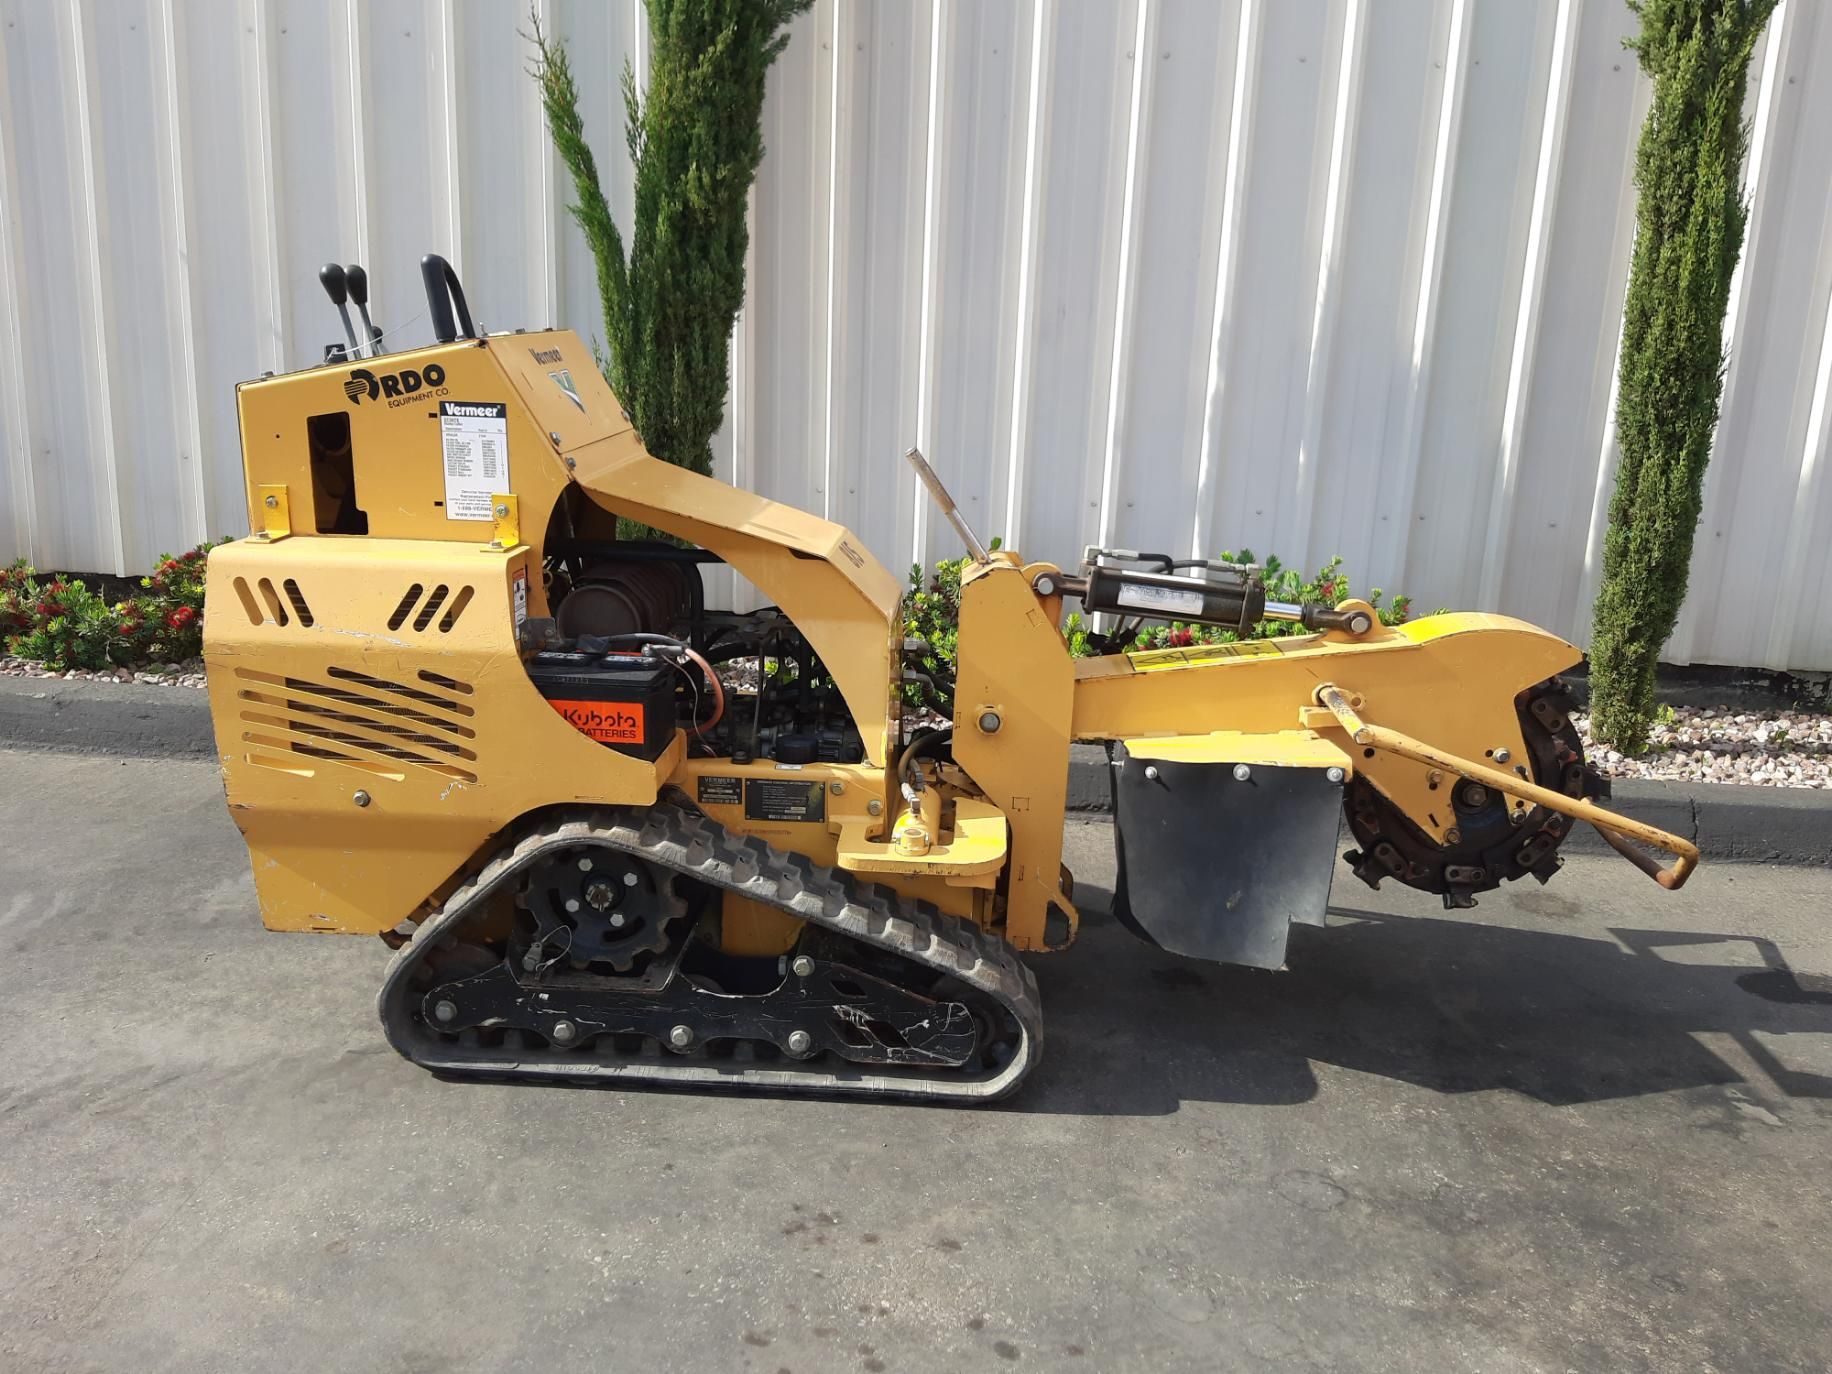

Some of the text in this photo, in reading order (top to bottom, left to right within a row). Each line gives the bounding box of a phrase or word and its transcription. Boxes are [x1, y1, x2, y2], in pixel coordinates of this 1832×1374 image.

[528, 347, 563, 366] Vermeer
[387, 387, 451, 409] EQUIPMENT CO.
[445, 403, 498, 416] Vermeer
[563, 708, 637, 728] Kubota
[577, 727, 637, 739] BATTERIES
